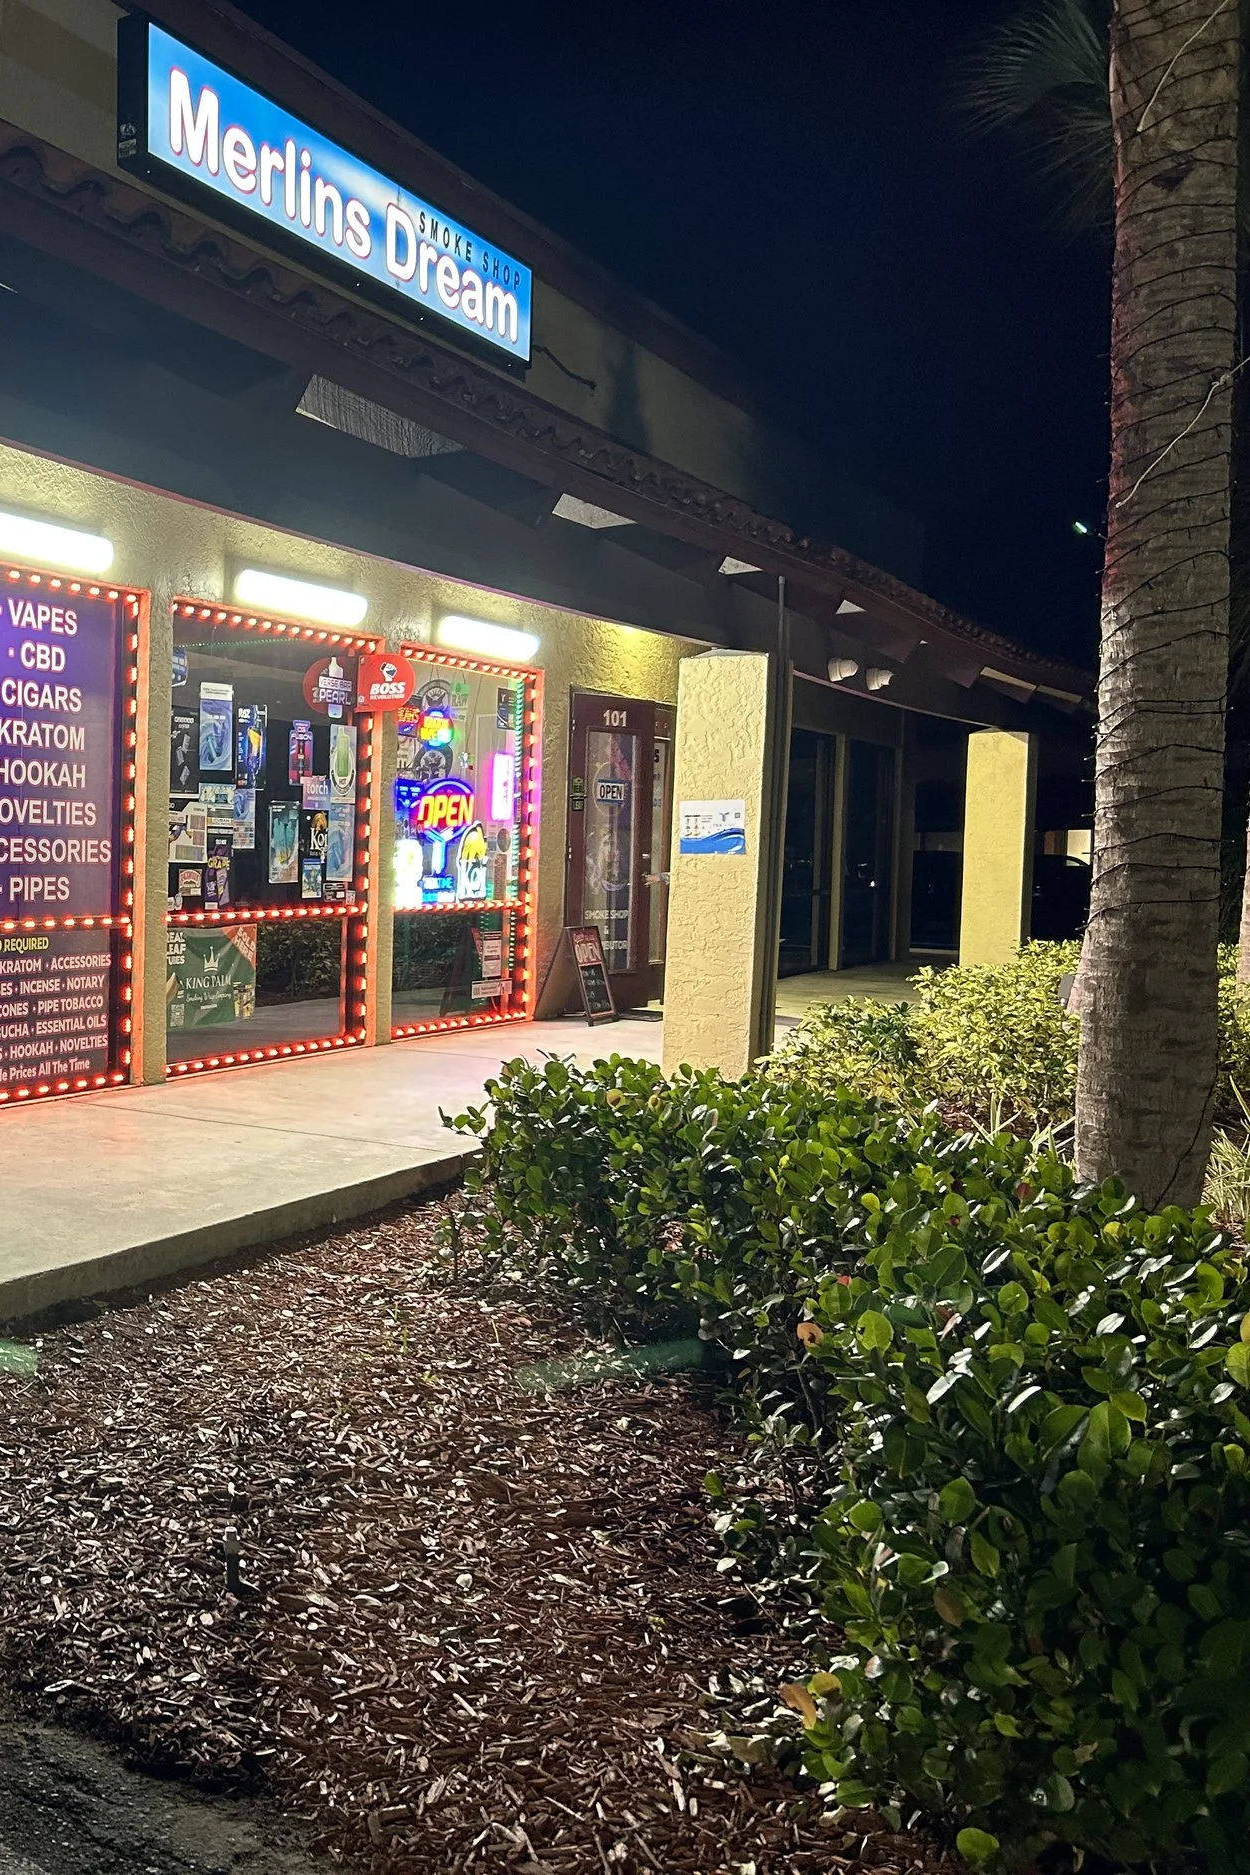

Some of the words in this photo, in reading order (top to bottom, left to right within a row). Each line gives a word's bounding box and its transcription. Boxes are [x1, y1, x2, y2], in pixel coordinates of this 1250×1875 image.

[169, 66, 371, 260] Merlins
[386, 202, 518, 344] Dream
[420, 212, 472, 263] SMOKE
[483, 251, 520, 290] SHOP
[8, 598, 78, 637] VAPES
[20, 640, 66, 673] CBD
[1, 679, 82, 712] CIGARS
[319, 689, 351, 705] PEARL
[370, 682, 406, 695] BOSS
[604, 710, 627, 727] 101
[306, 782, 328, 795] torch
[600, 785, 622, 799] OPEN
[417, 795, 474, 829] OPEN
[208, 859, 230, 868] GRAPE
[9, 877, 70, 901] PIPES
[585, 910, 609, 919] SMOKE
[610, 910, 628, 919] SHOP
[4, 937, 49, 954] REQUIRED
[233, 935, 252, 960] HERE
[237, 926, 256, 953] SOLD
[575, 941, 601, 962] OPEN
[0, 959, 42, 974] KRATOM
[51, 954, 111, 971] ACCESSORIES
[20, 979, 60, 994] INCENSE
[67, 975, 105, 990] NOTARY
[186, 976, 210, 990] KING
[212, 975, 232, 987] PALM
[38, 1000, 59, 1014] PIPE
[61, 996, 103, 1011] TOBACCO
[36, 1017, 85, 1034] ESSENTIAL
[87, 1014, 107, 1028] OILS
[10, 1041, 53, 1060] HOOKAH
[60, 1035, 108, 1052] NOVELTIES
[10, 1065, 37, 1081] Prices
[38, 1062, 51, 1076] All
[52, 1060, 68, 1073] The
[69, 1058, 90, 1071] Time
